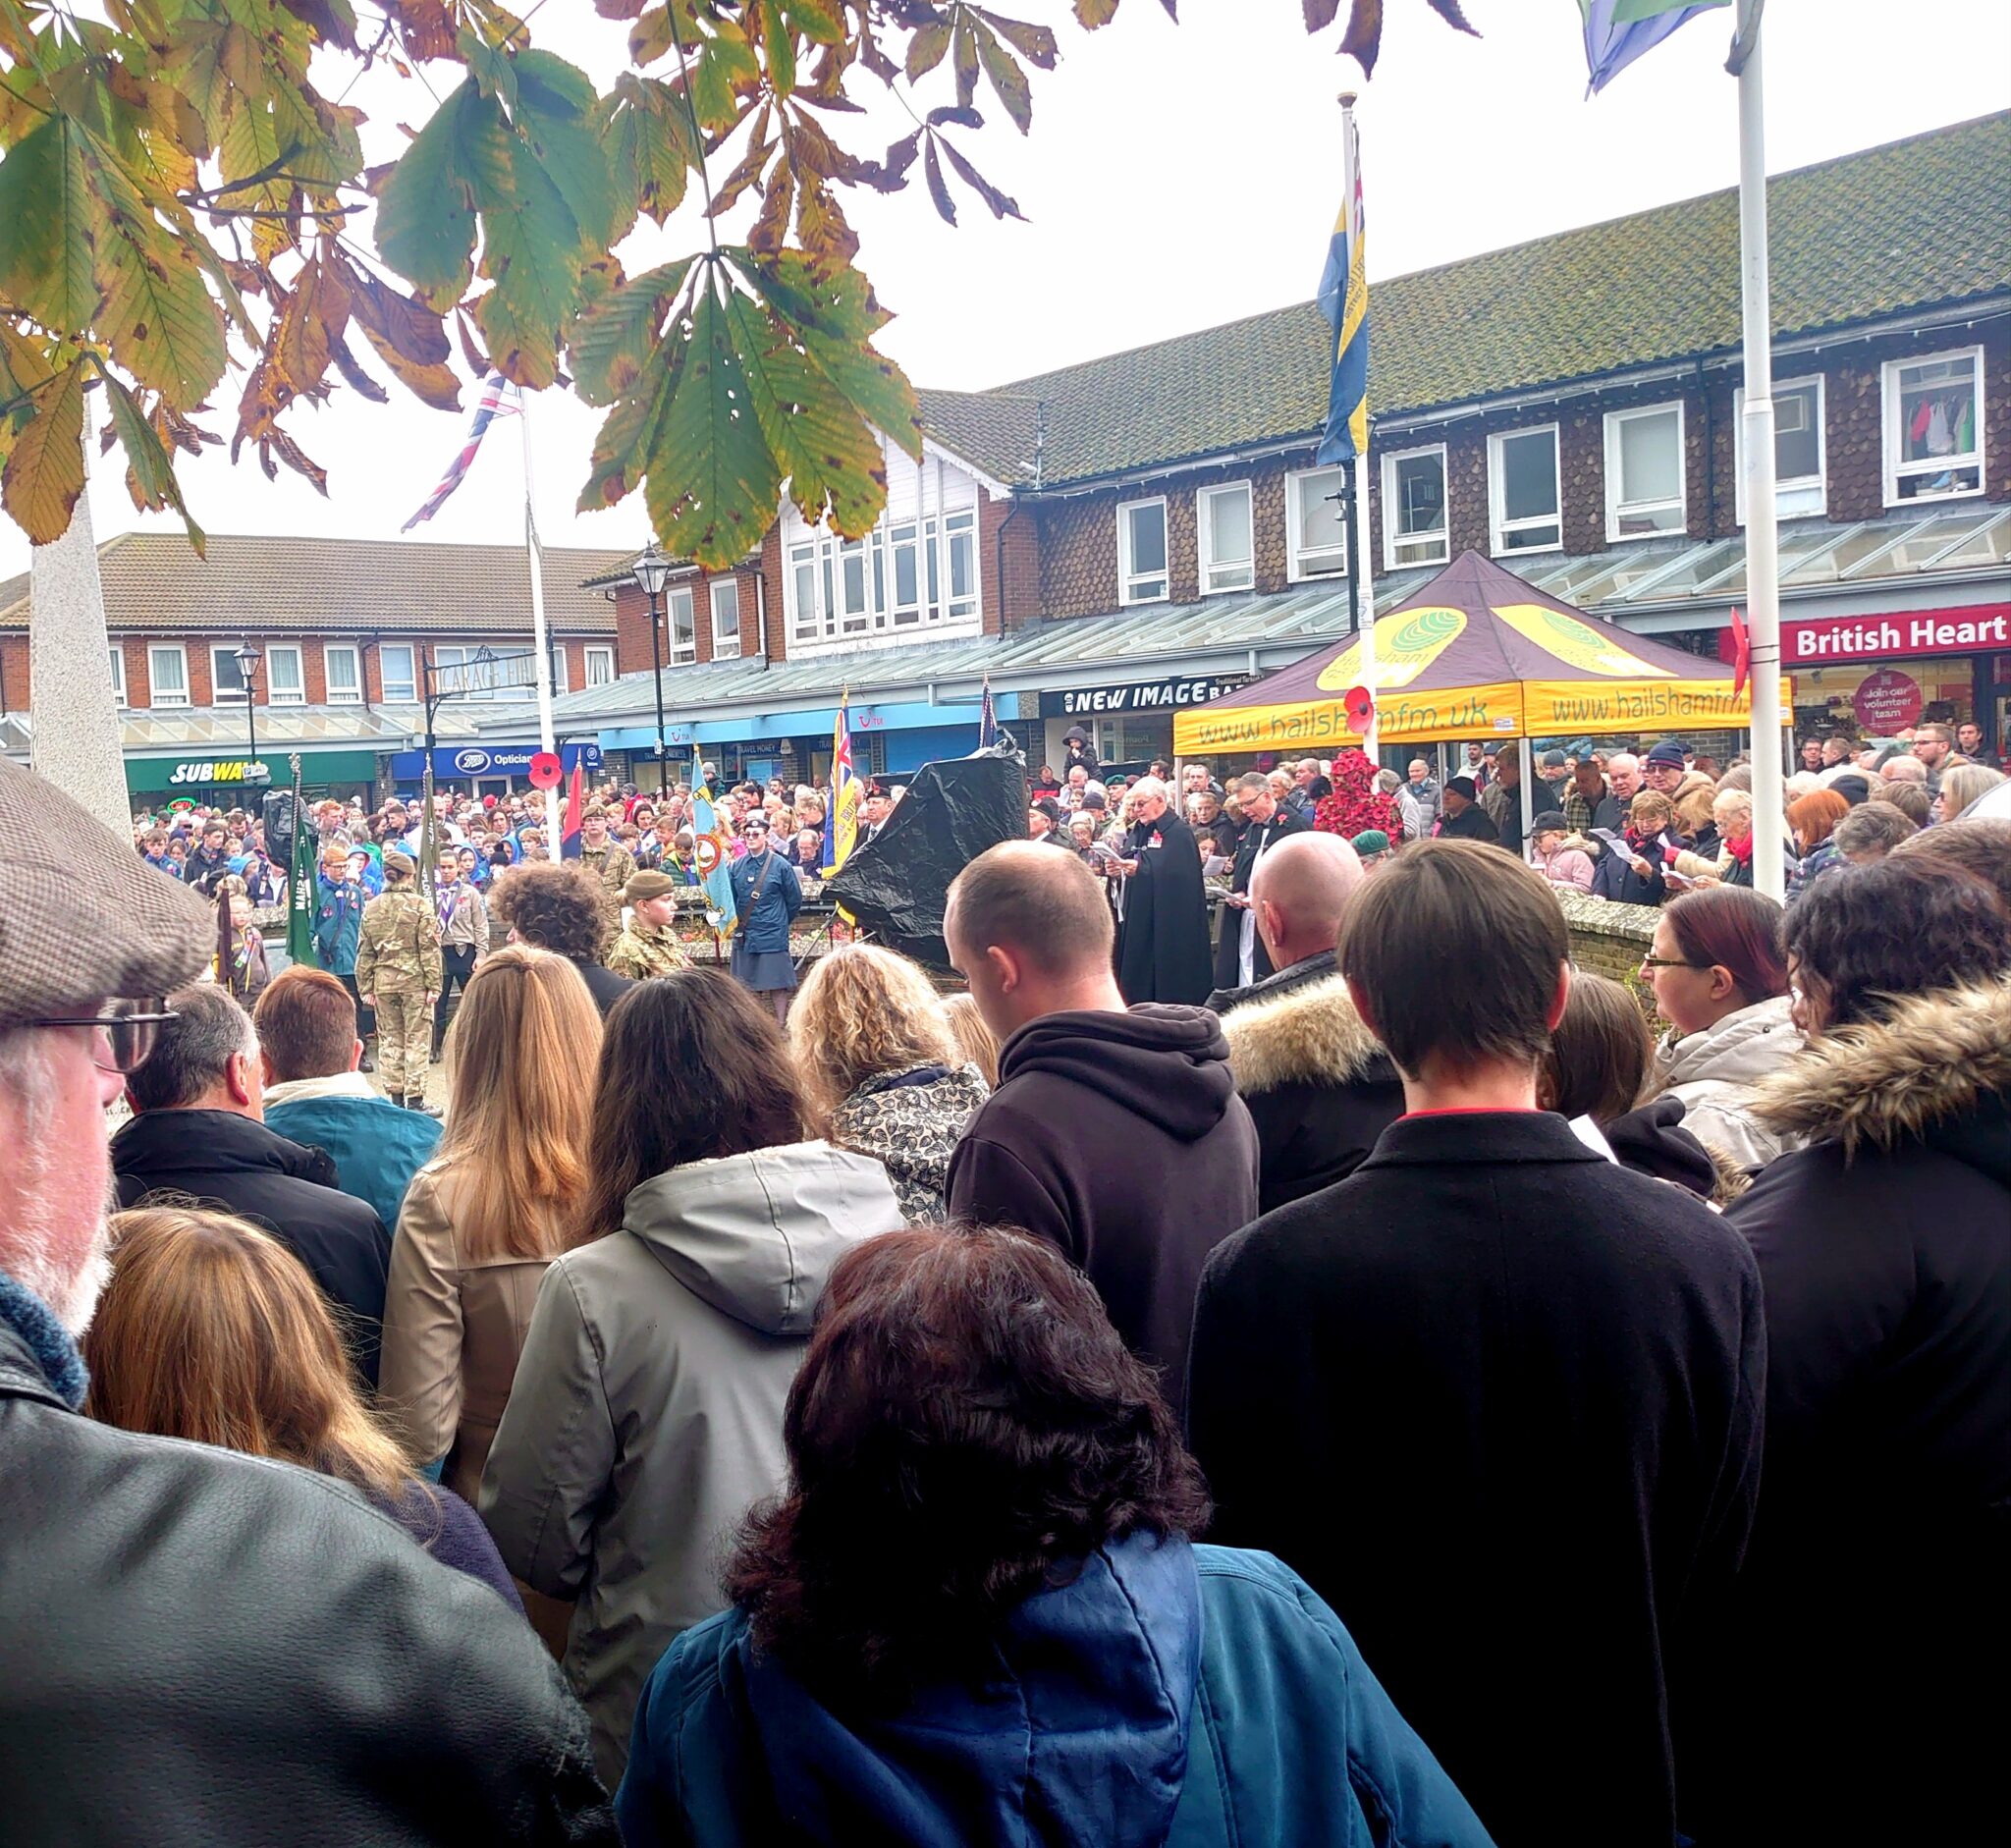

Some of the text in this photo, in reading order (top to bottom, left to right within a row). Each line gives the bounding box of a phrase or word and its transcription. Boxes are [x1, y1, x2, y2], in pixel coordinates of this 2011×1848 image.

[1797, 616, 2007, 657] British Heart
[428, 660, 502, 695] VICARAGE
[1866, 687, 1888, 698] Join
[1075, 689, 1127, 712] NEW
[1132, 681, 1207, 707] IMAGE
[1552, 686, 1749, 722] www.hailshamfm.
[1864, 698, 1912, 708] volunteer
[1198, 696, 1489, 745] www.hailshmfm.uk
[1875, 709, 1901, 718] team
[495, 754, 533, 767] Optician
